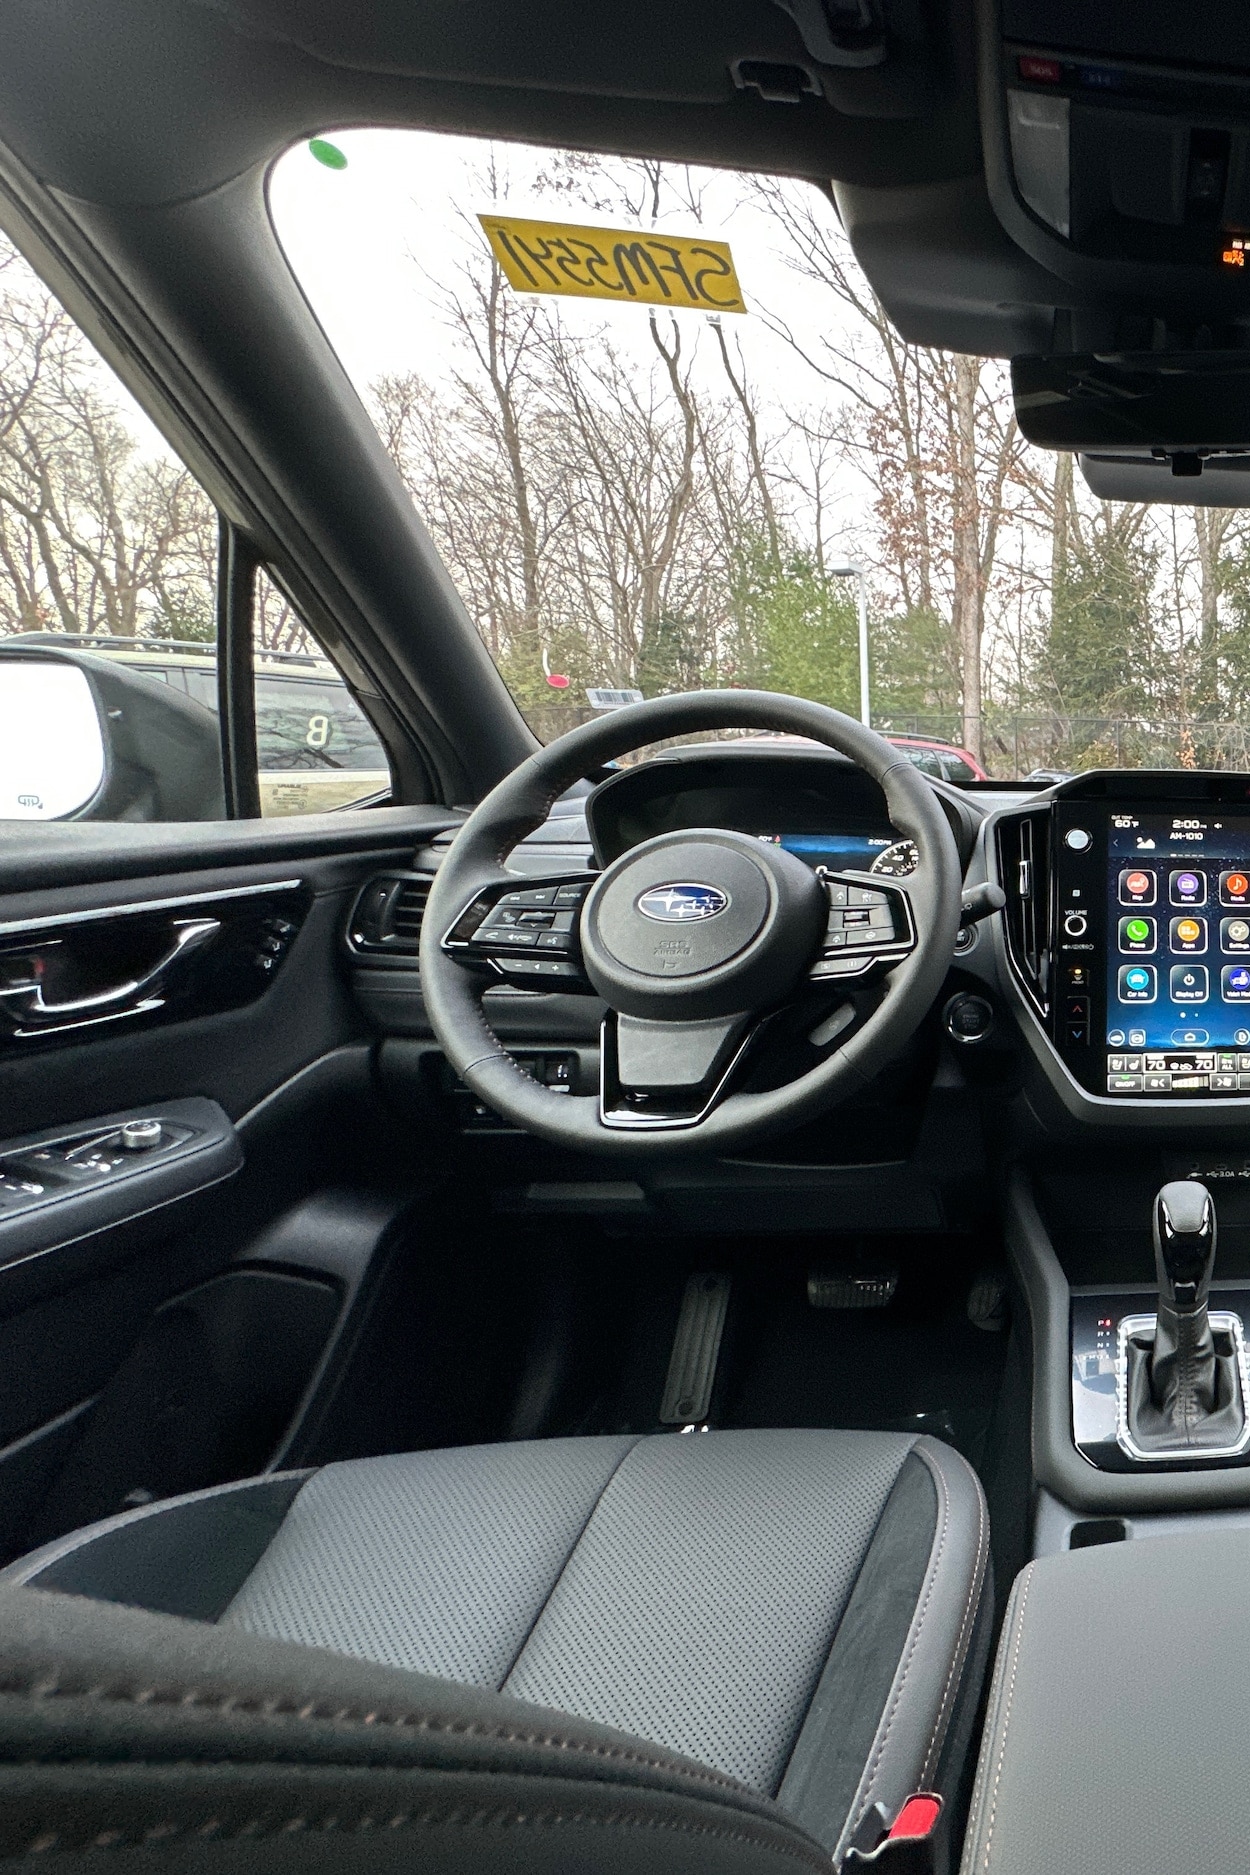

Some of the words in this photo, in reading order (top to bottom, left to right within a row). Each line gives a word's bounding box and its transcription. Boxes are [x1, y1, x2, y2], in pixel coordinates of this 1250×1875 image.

[1172, 819, 1200, 829] 2:00
[1169, 832, 1204, 841] AM-1010
[1147, 1060, 1166, 1070] 70
[1194, 1059, 1213, 1070] 70
